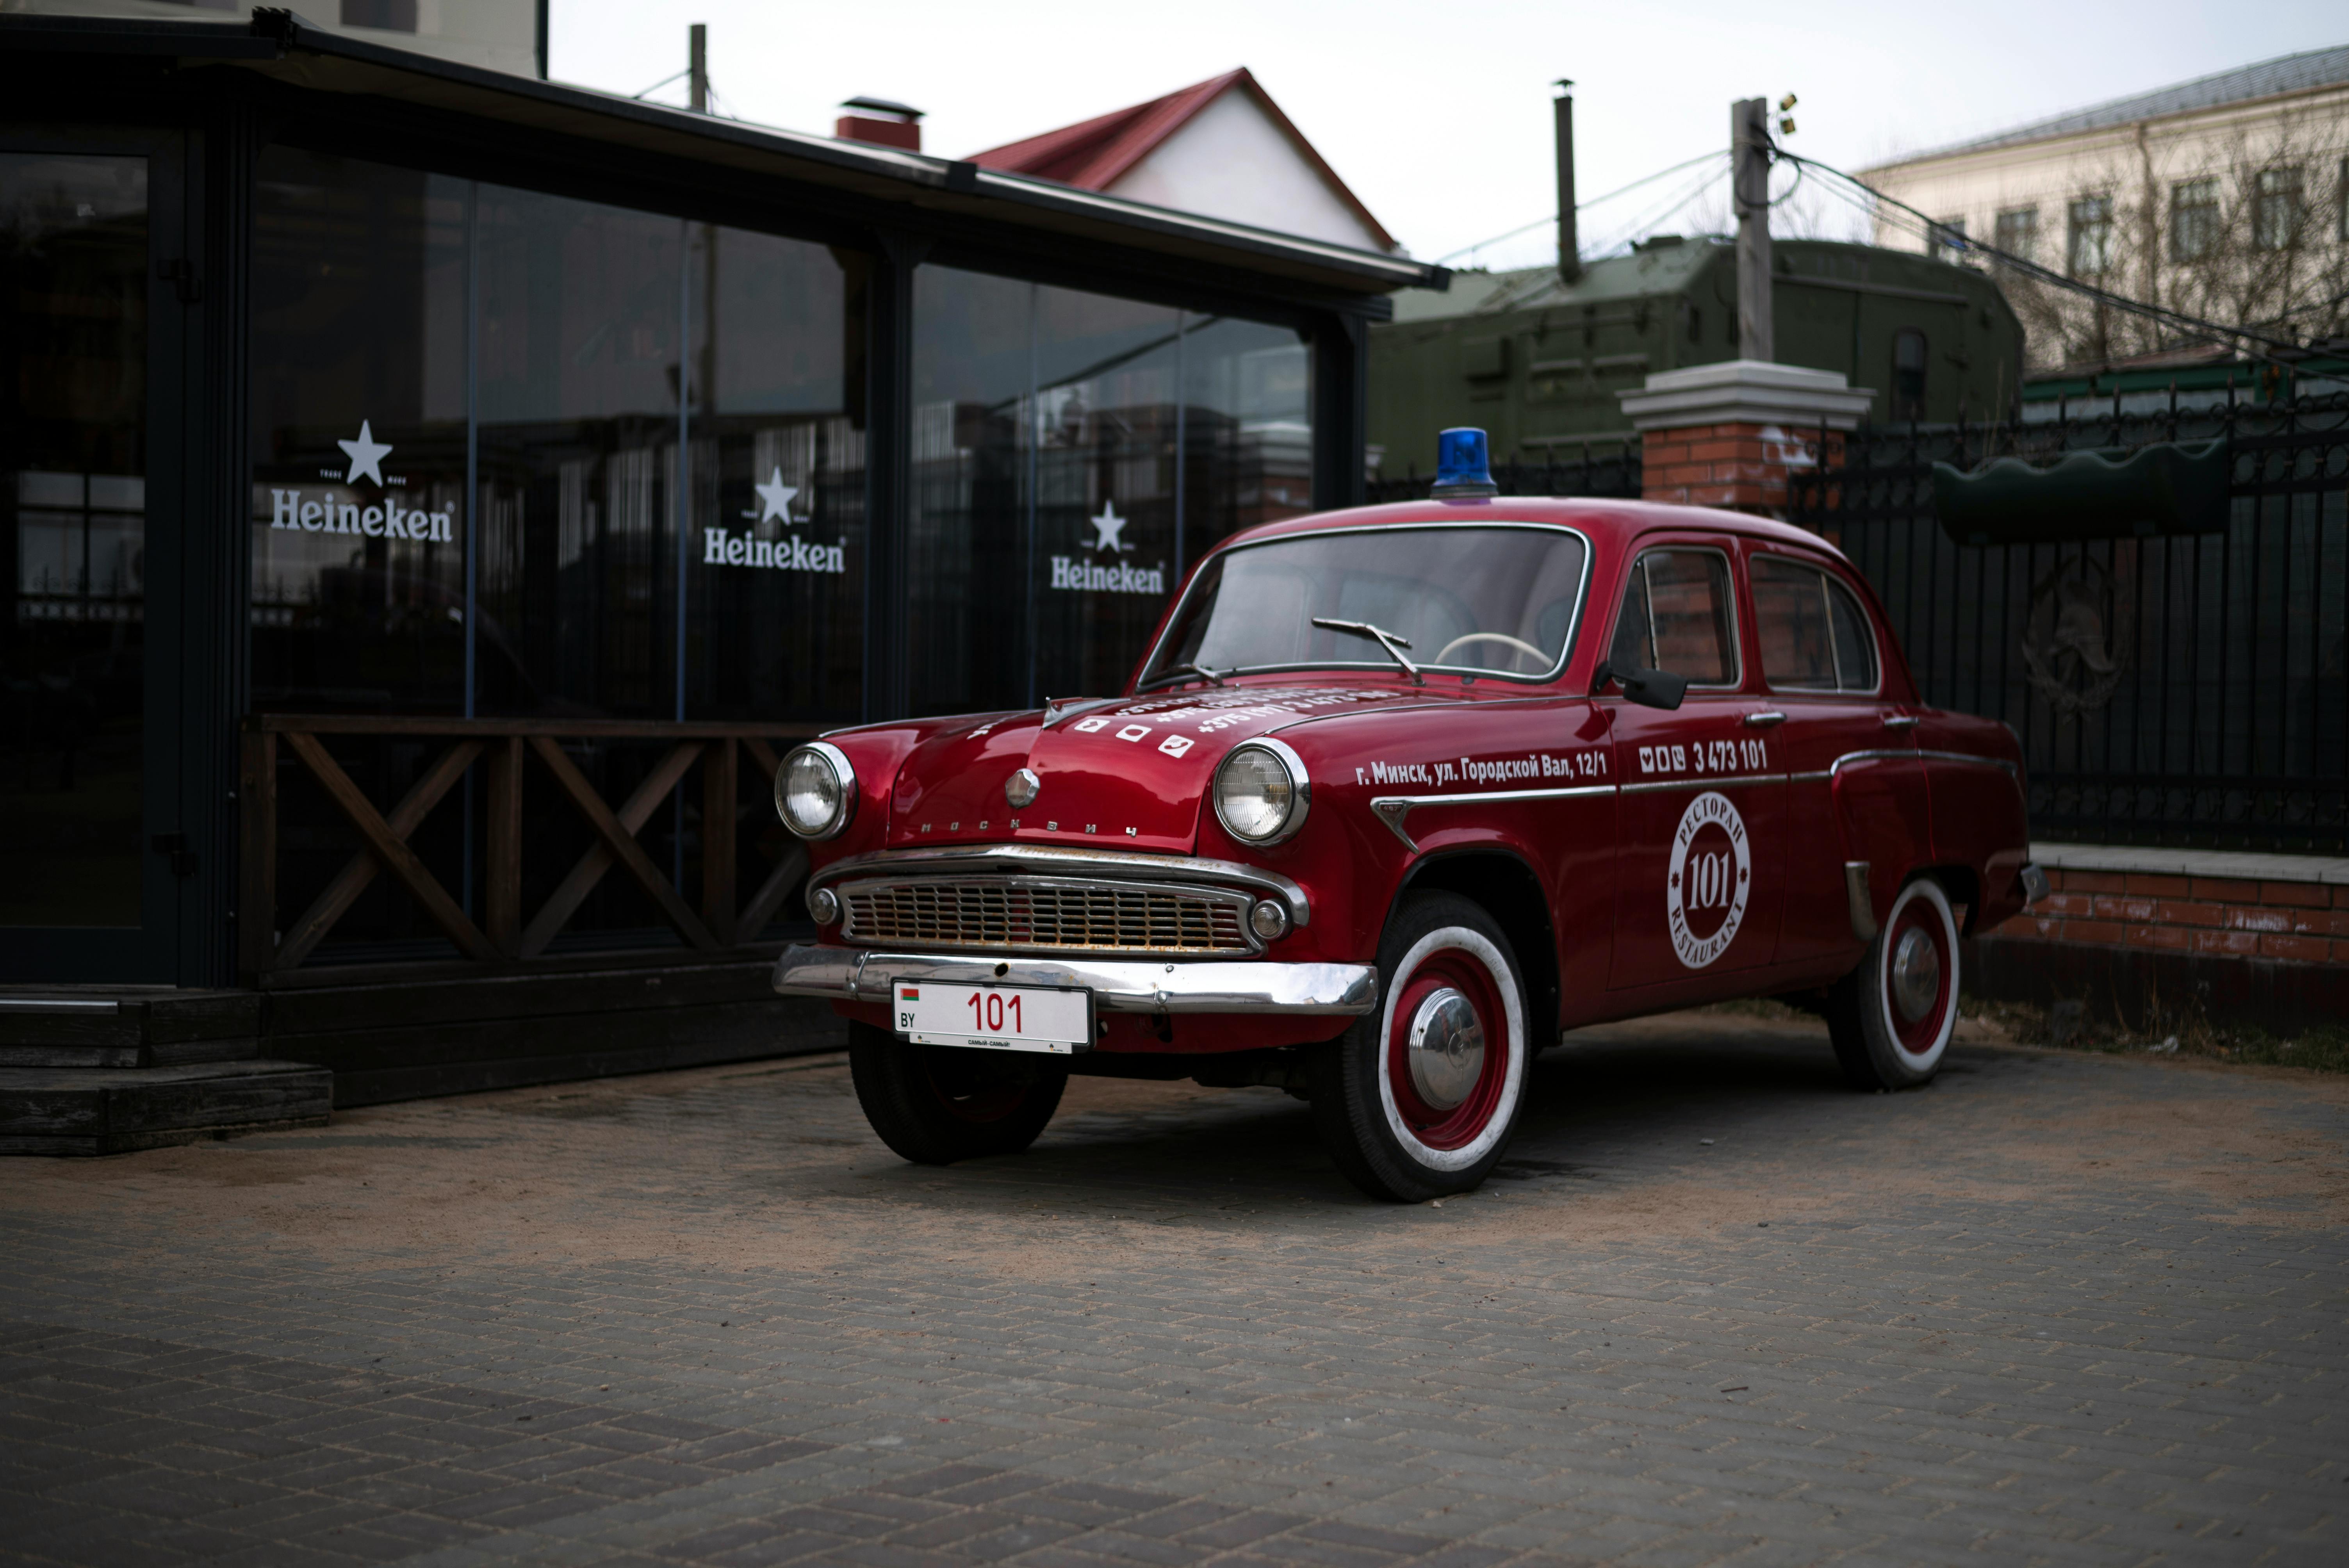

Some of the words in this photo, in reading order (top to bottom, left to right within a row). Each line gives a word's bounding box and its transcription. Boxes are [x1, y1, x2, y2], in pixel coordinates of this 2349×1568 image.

[271, 488, 453, 543] Heineken
[704, 527, 845, 574] Heineken
[1051, 555, 1164, 594] Heineken
[1156, 707, 1208, 722] +375
[1198, 714, 1251, 732] +375
[1356, 768, 1369, 785] г.
[1371, 761, 1432, 786] Минск,
[1434, 763, 1458, 786] ул.
[1461, 754, 1539, 784] Городской
[1541, 754, 1574, 780] Вал,
[1576, 751, 1606, 776] 12/1
[1693, 741, 1704, 773] 3
[1708, 740, 1737, 772] 473
[1740, 738, 1767, 770] 101
[1679, 796, 1743, 847] РЕСТОРАН
[1687, 850, 1729, 911] 101
[1671, 897, 1743, 964] RESTAURANT
[900, 1013, 915, 1028] BY
[968, 992, 1021, 1033] 101
